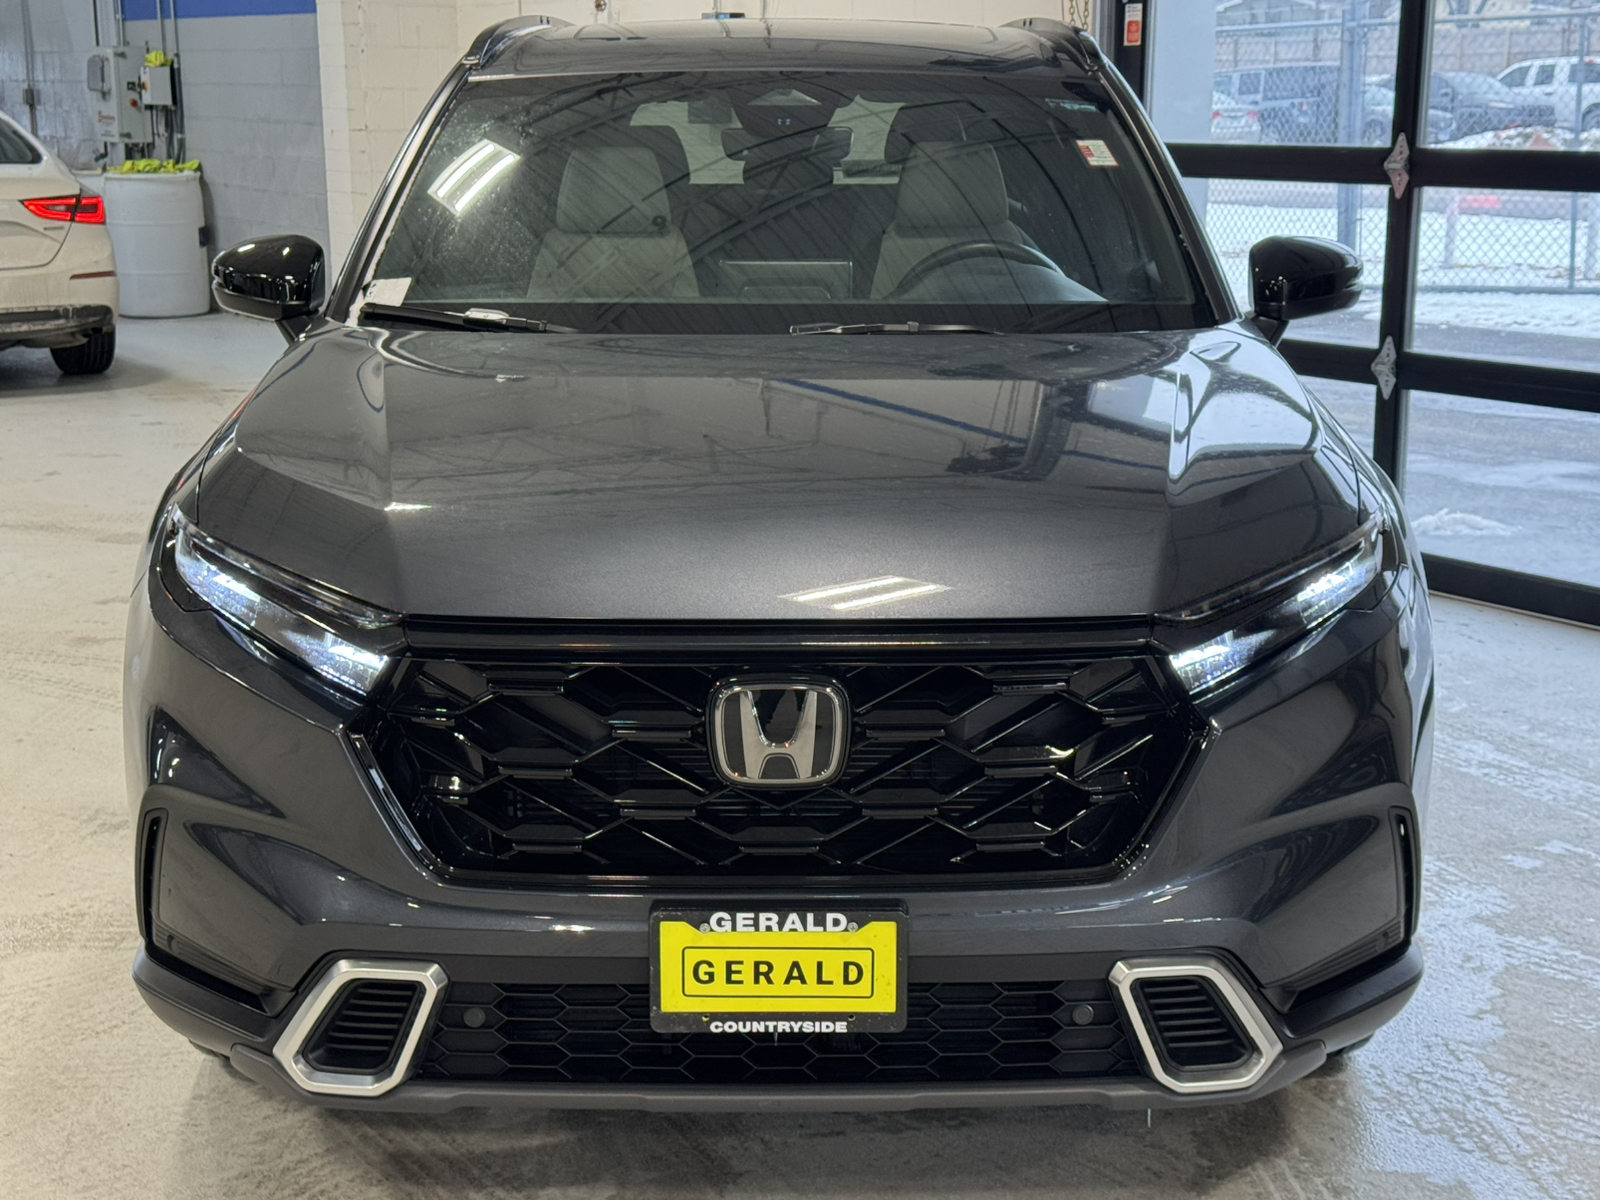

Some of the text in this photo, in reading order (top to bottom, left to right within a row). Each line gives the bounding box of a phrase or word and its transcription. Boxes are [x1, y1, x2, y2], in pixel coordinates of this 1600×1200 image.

[709, 912, 848, 933] GERALD
[692, 960, 864, 986] GERALD
[709, 1021, 848, 1033] COUNTRYSIDE
